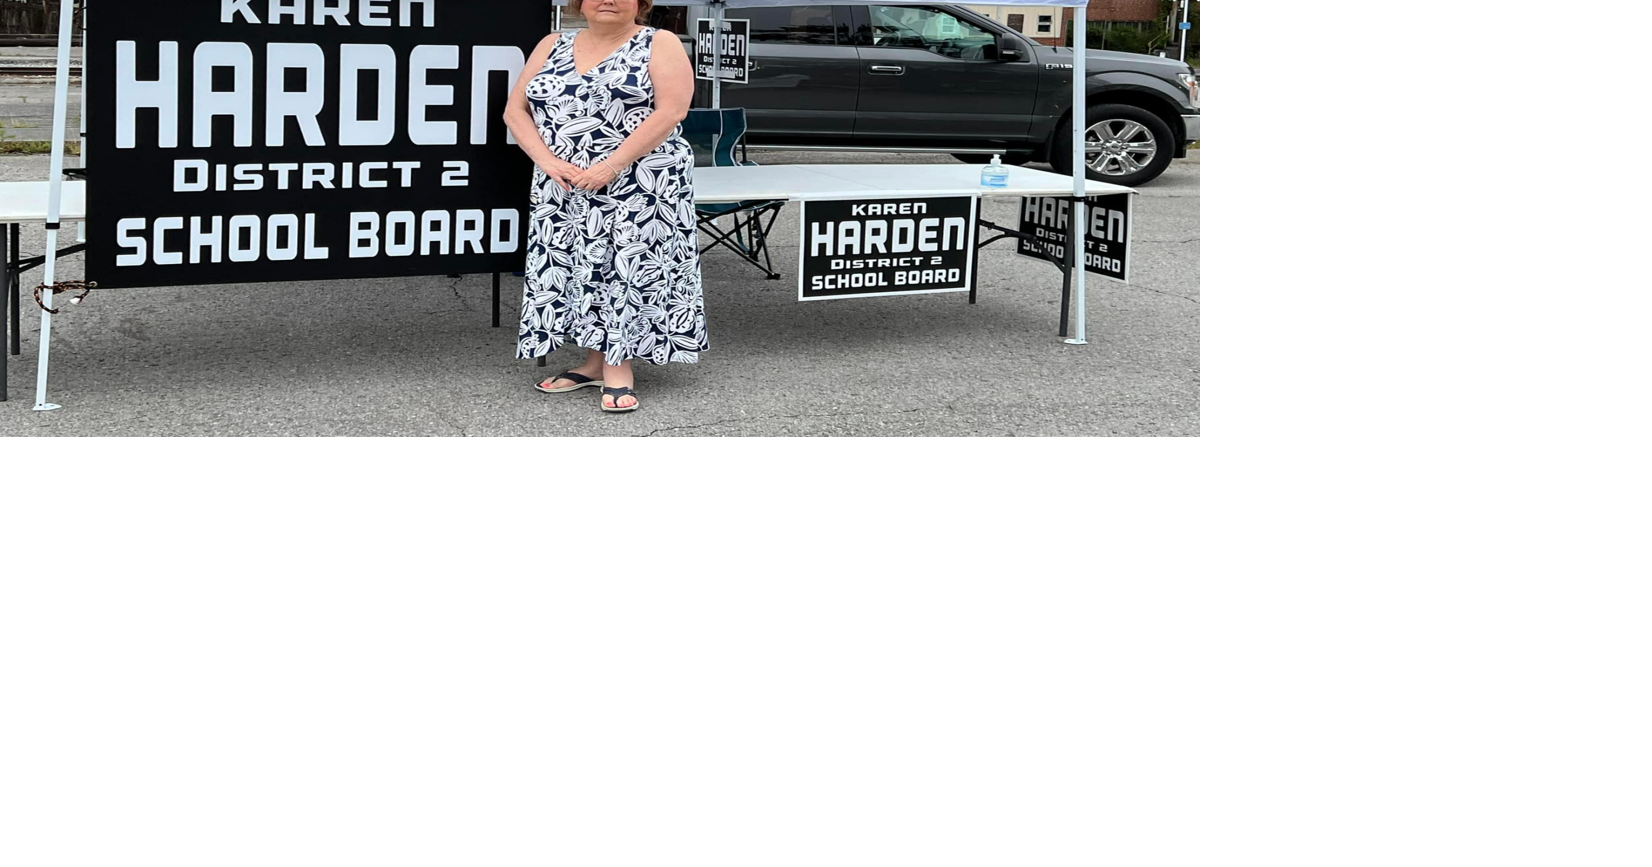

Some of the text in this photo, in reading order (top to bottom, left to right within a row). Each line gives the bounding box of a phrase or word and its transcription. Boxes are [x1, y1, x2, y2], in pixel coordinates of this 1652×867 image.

[220, 0, 435, 27] KAREN
[698, 33, 745, 57] HADEN
[115, 40, 526, 149] HARDEN
[173, 159, 470, 192] DISTRICT 2
[851, 202, 927, 216] KAREN
[115, 208, 520, 267] SCHOOL BOARD
[810, 217, 966, 257] HARDEN
[1098, 243, 1108, 253] 2
[830, 256, 943, 270] DISTRICT 2
[1084, 252, 1121, 273] OARD
[811, 268, 960, 290] SCHOOL BOARD
